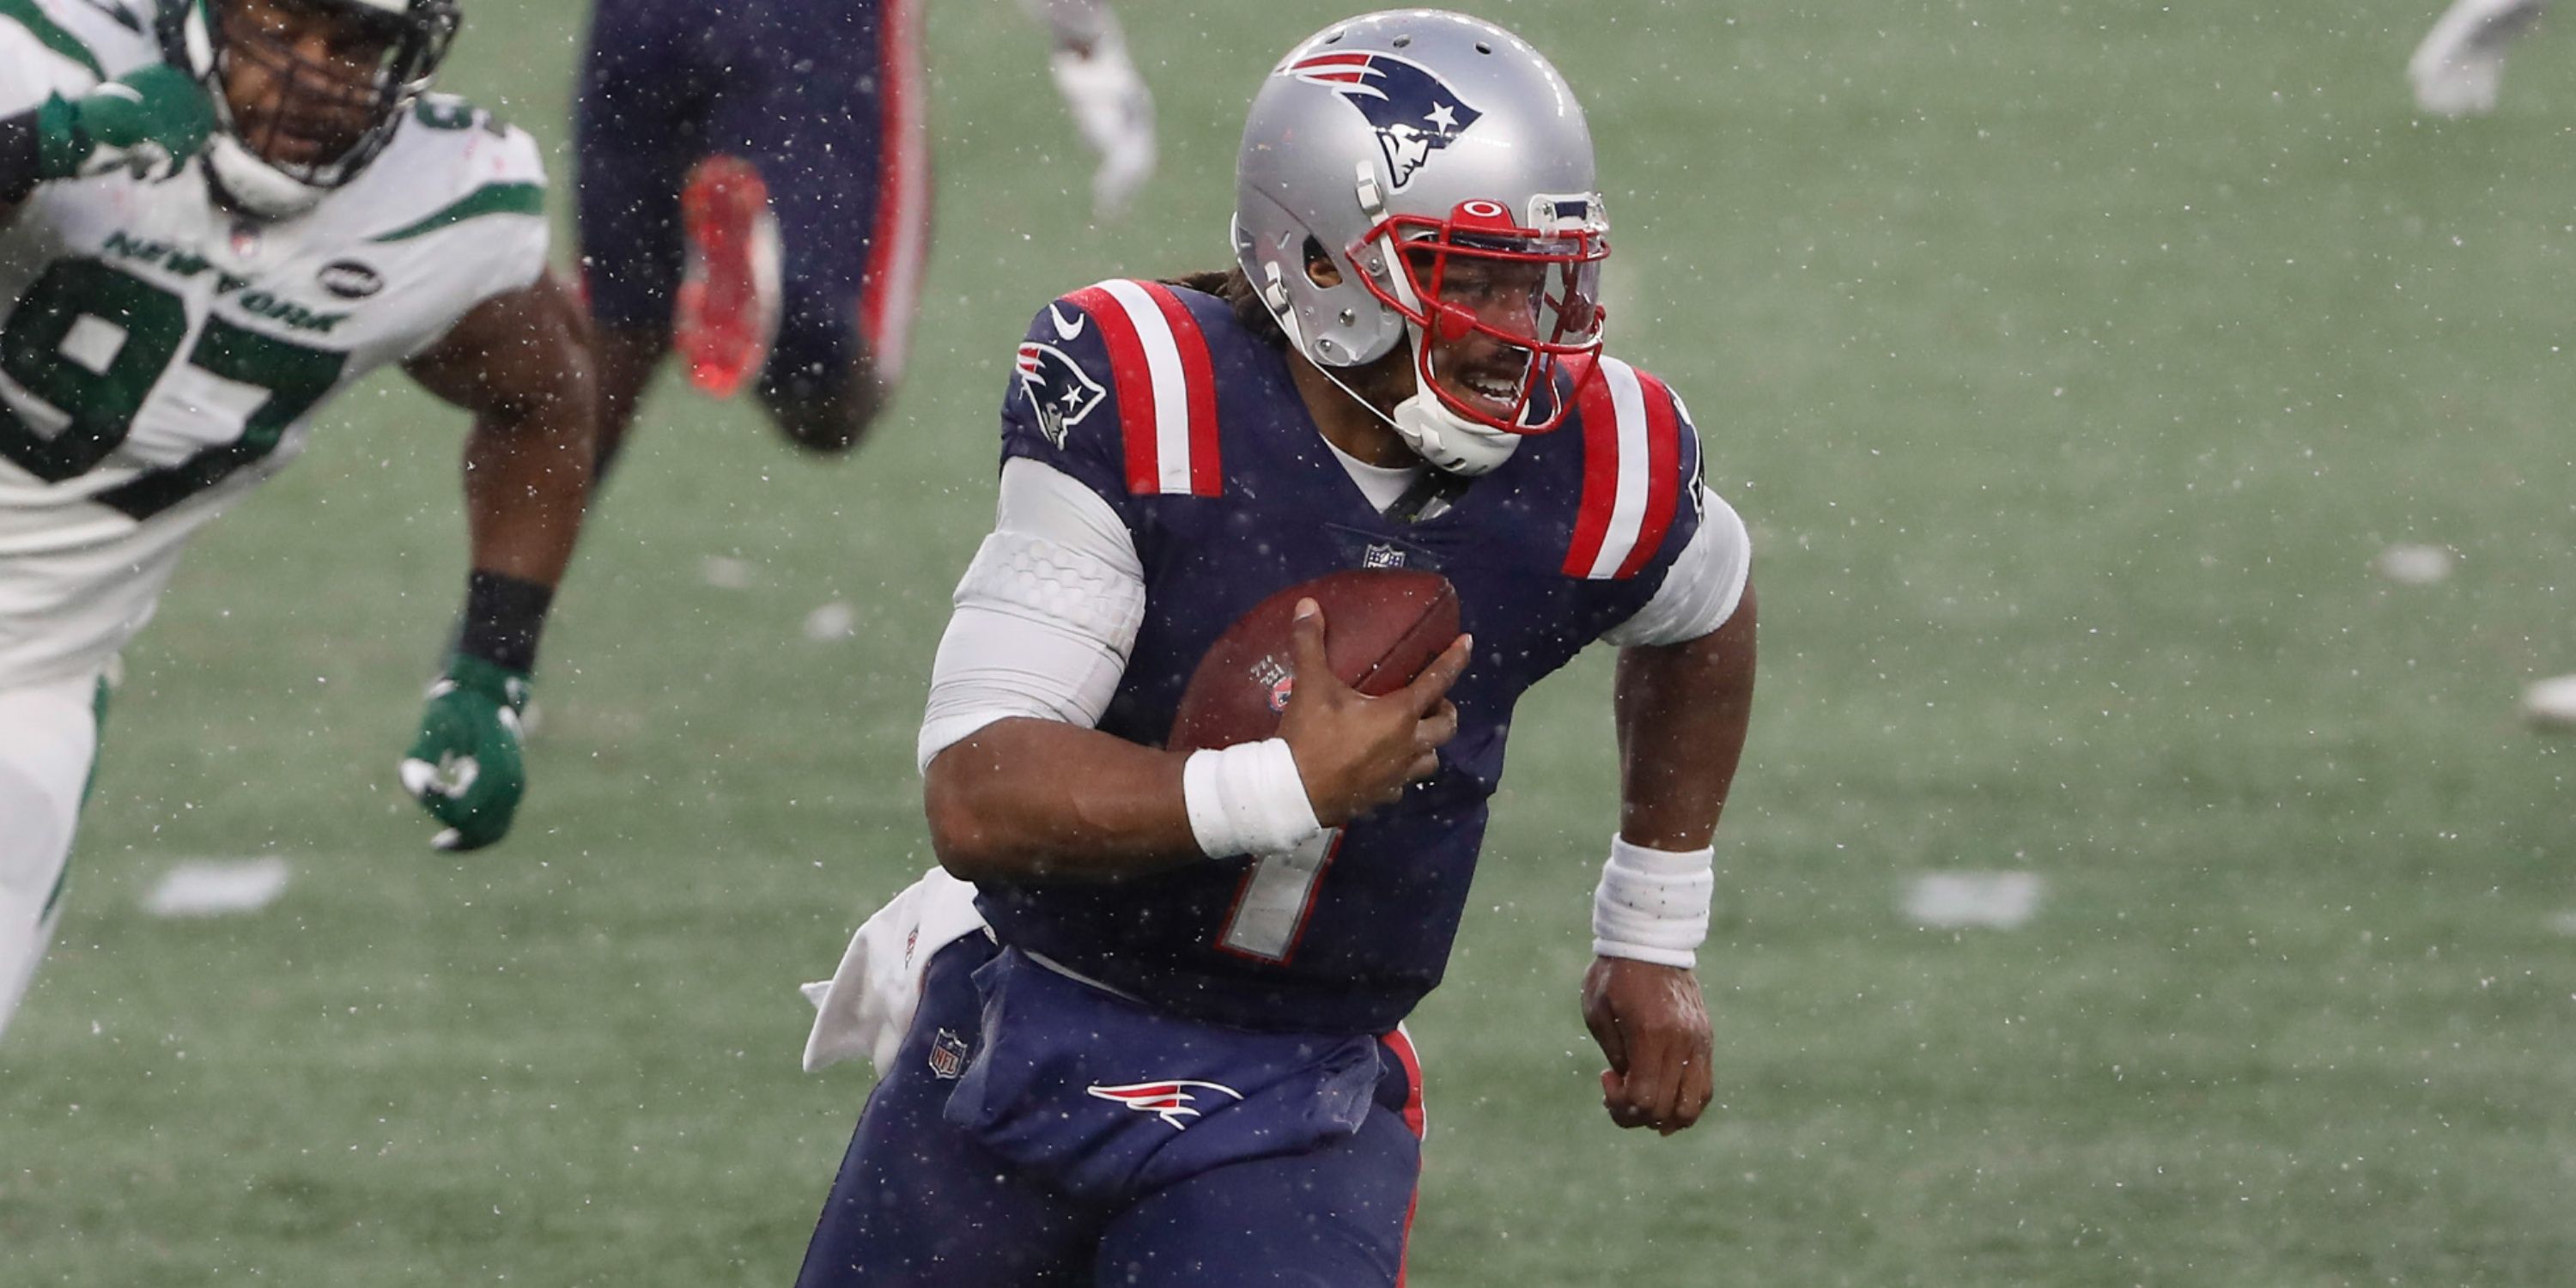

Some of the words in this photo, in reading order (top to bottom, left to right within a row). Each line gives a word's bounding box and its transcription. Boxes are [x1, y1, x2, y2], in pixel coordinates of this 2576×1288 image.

[102, 230, 213, 276] NEW
[216, 270, 354, 332] YORK
[0, 257, 350, 523] 97
[933, 1045, 960, 1073] NFL
